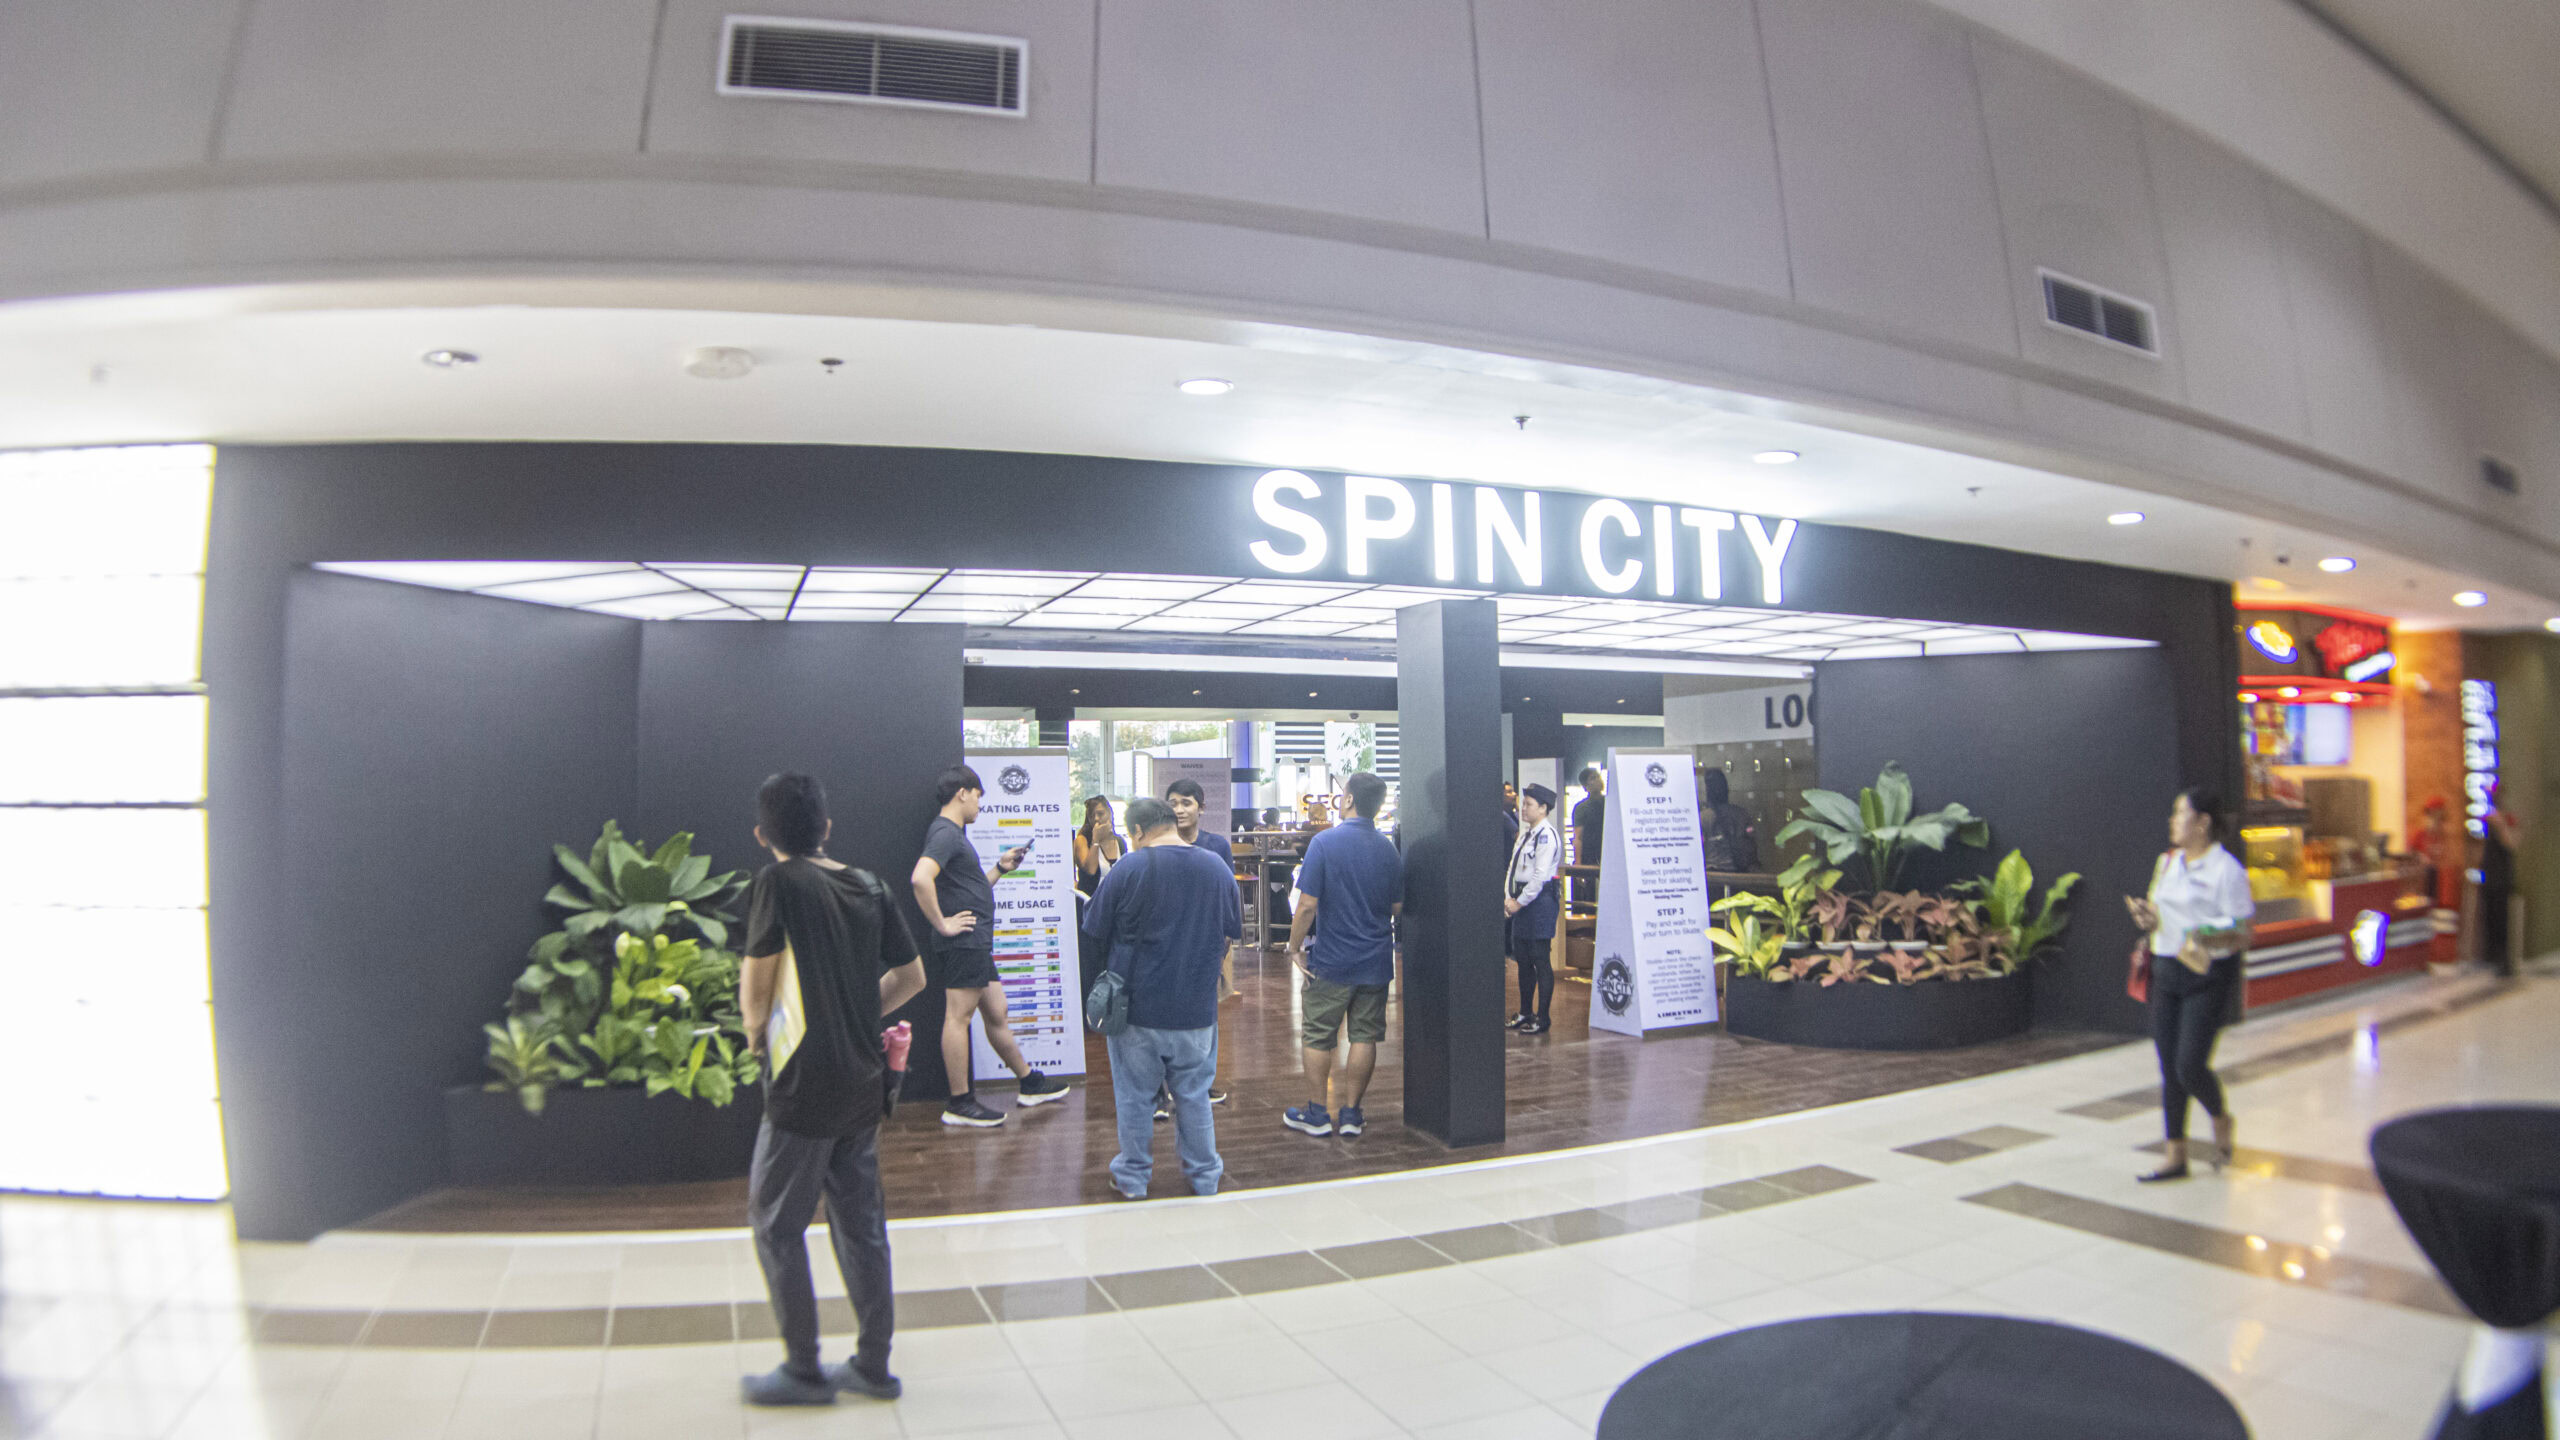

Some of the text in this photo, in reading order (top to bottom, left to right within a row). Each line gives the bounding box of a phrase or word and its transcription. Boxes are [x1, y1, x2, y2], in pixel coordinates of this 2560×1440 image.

[1249, 468, 1798, 605] SPIN CITY
[978, 804, 1060, 813] KATING RATES
[1652, 856, 1679, 865] STEP 2
[994, 899, 1055, 910] IME USAGE
[1657, 907, 1684, 917] STEP 3
[1646, 920, 1657, 929] Pay
[1660, 919, 1672, 928] and
[1673, 919, 1686, 927] wait
[1658, 929, 1673, 937] turn
[1674, 928, 1682, 936] to
[1597, 978, 1634, 995] SPIN CITY
